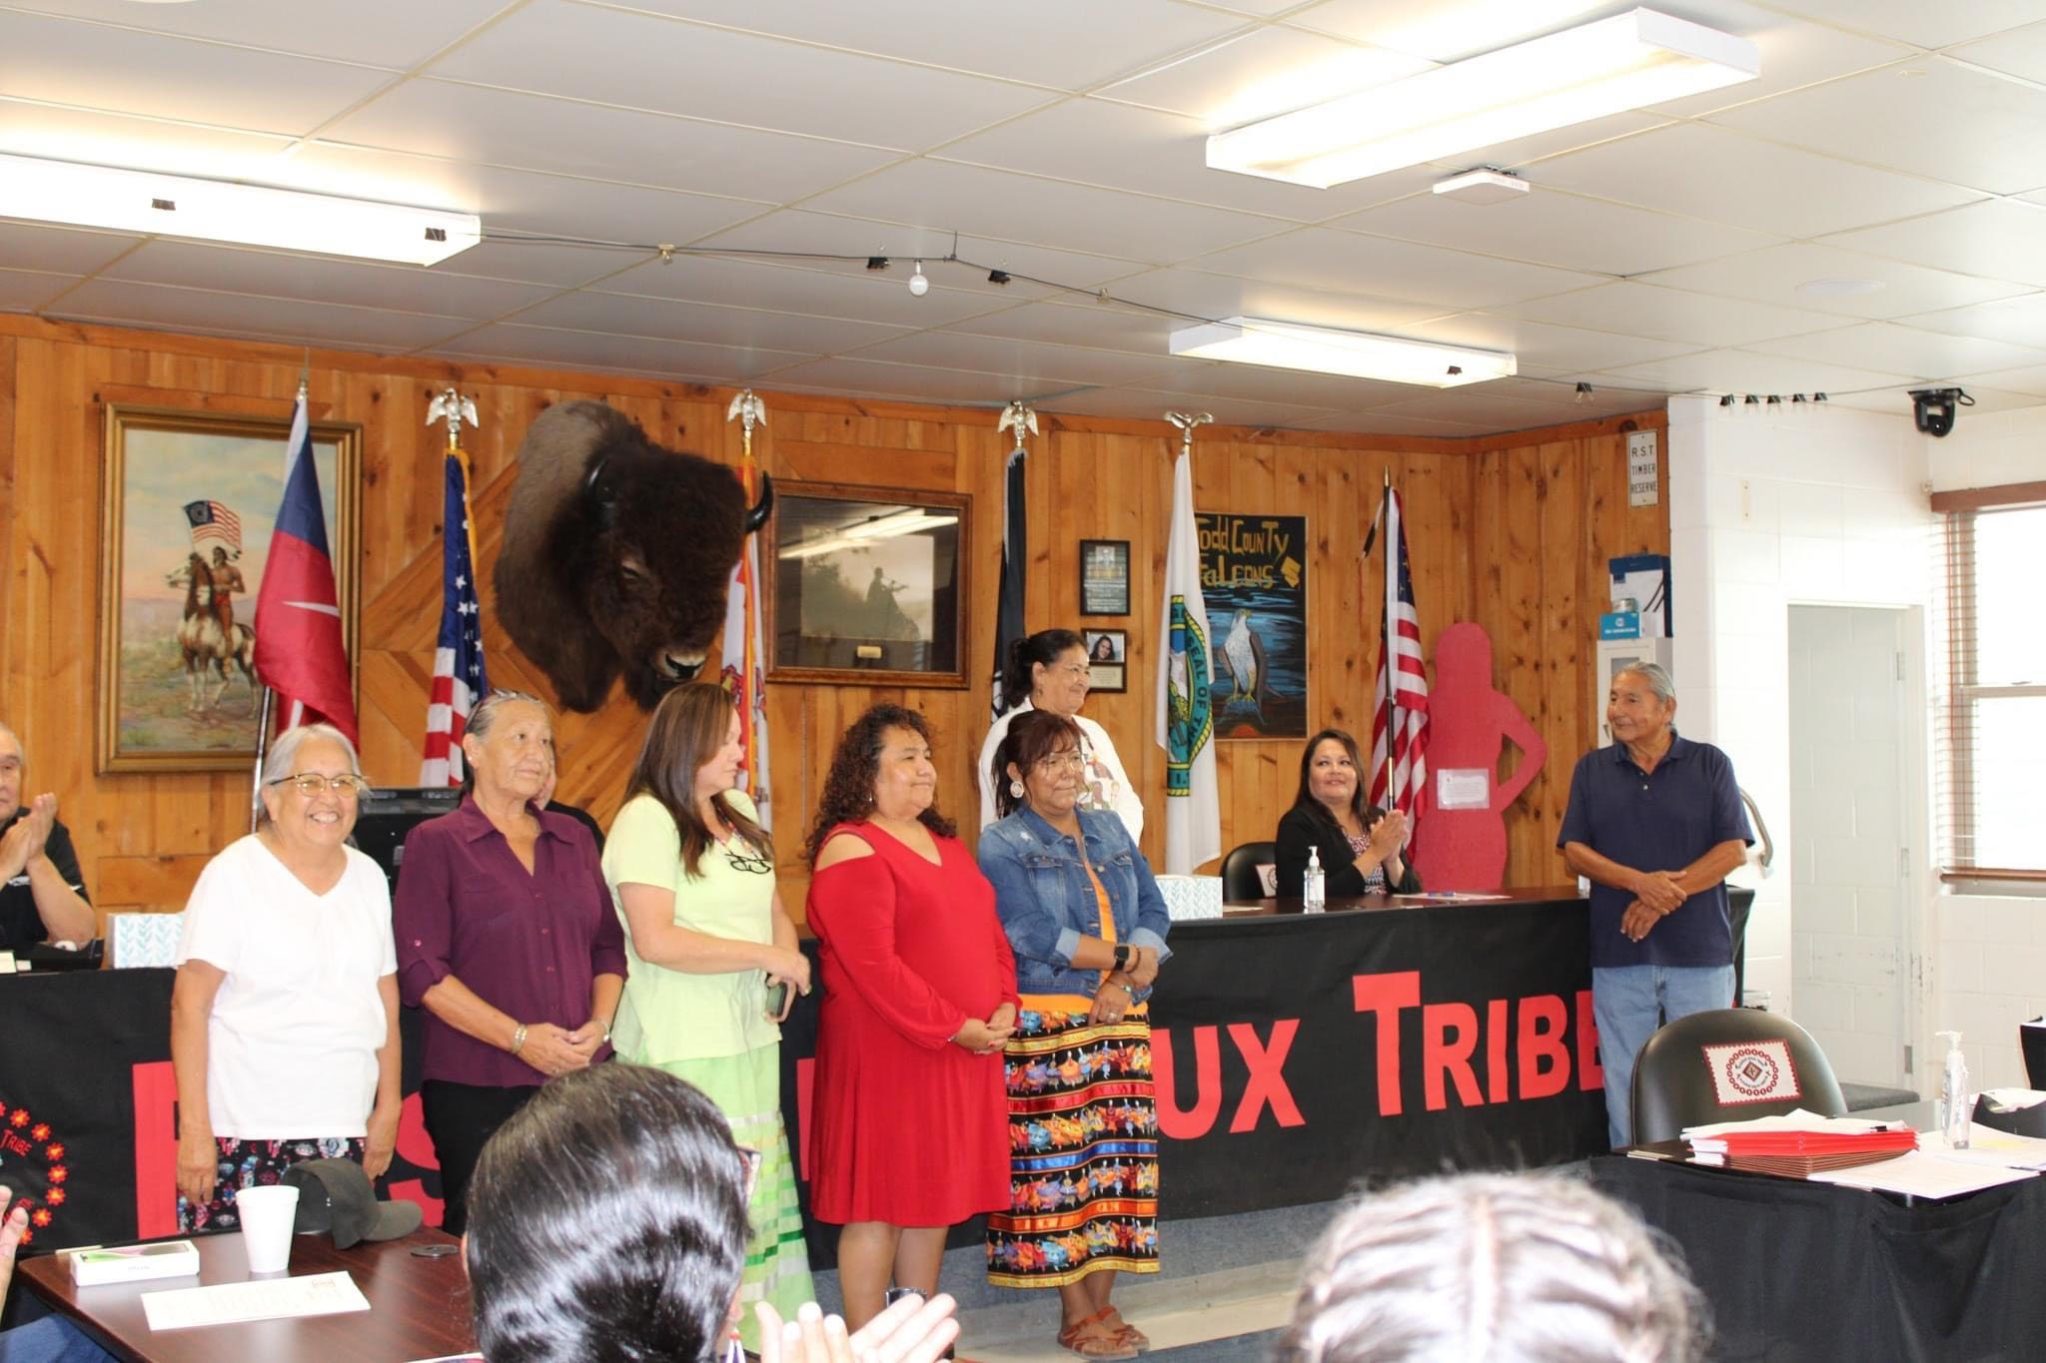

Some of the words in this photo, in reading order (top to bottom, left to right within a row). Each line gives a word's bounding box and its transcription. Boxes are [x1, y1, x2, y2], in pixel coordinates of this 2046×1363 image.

[1631, 463, 1656, 476] TIMBER
[1630, 480, 1657, 494] RESERVE
[1188, 636, 1207, 680] SEAL
[1197, 687, 1208, 709] OF
[0, 1129, 33, 1157] TRIBE
